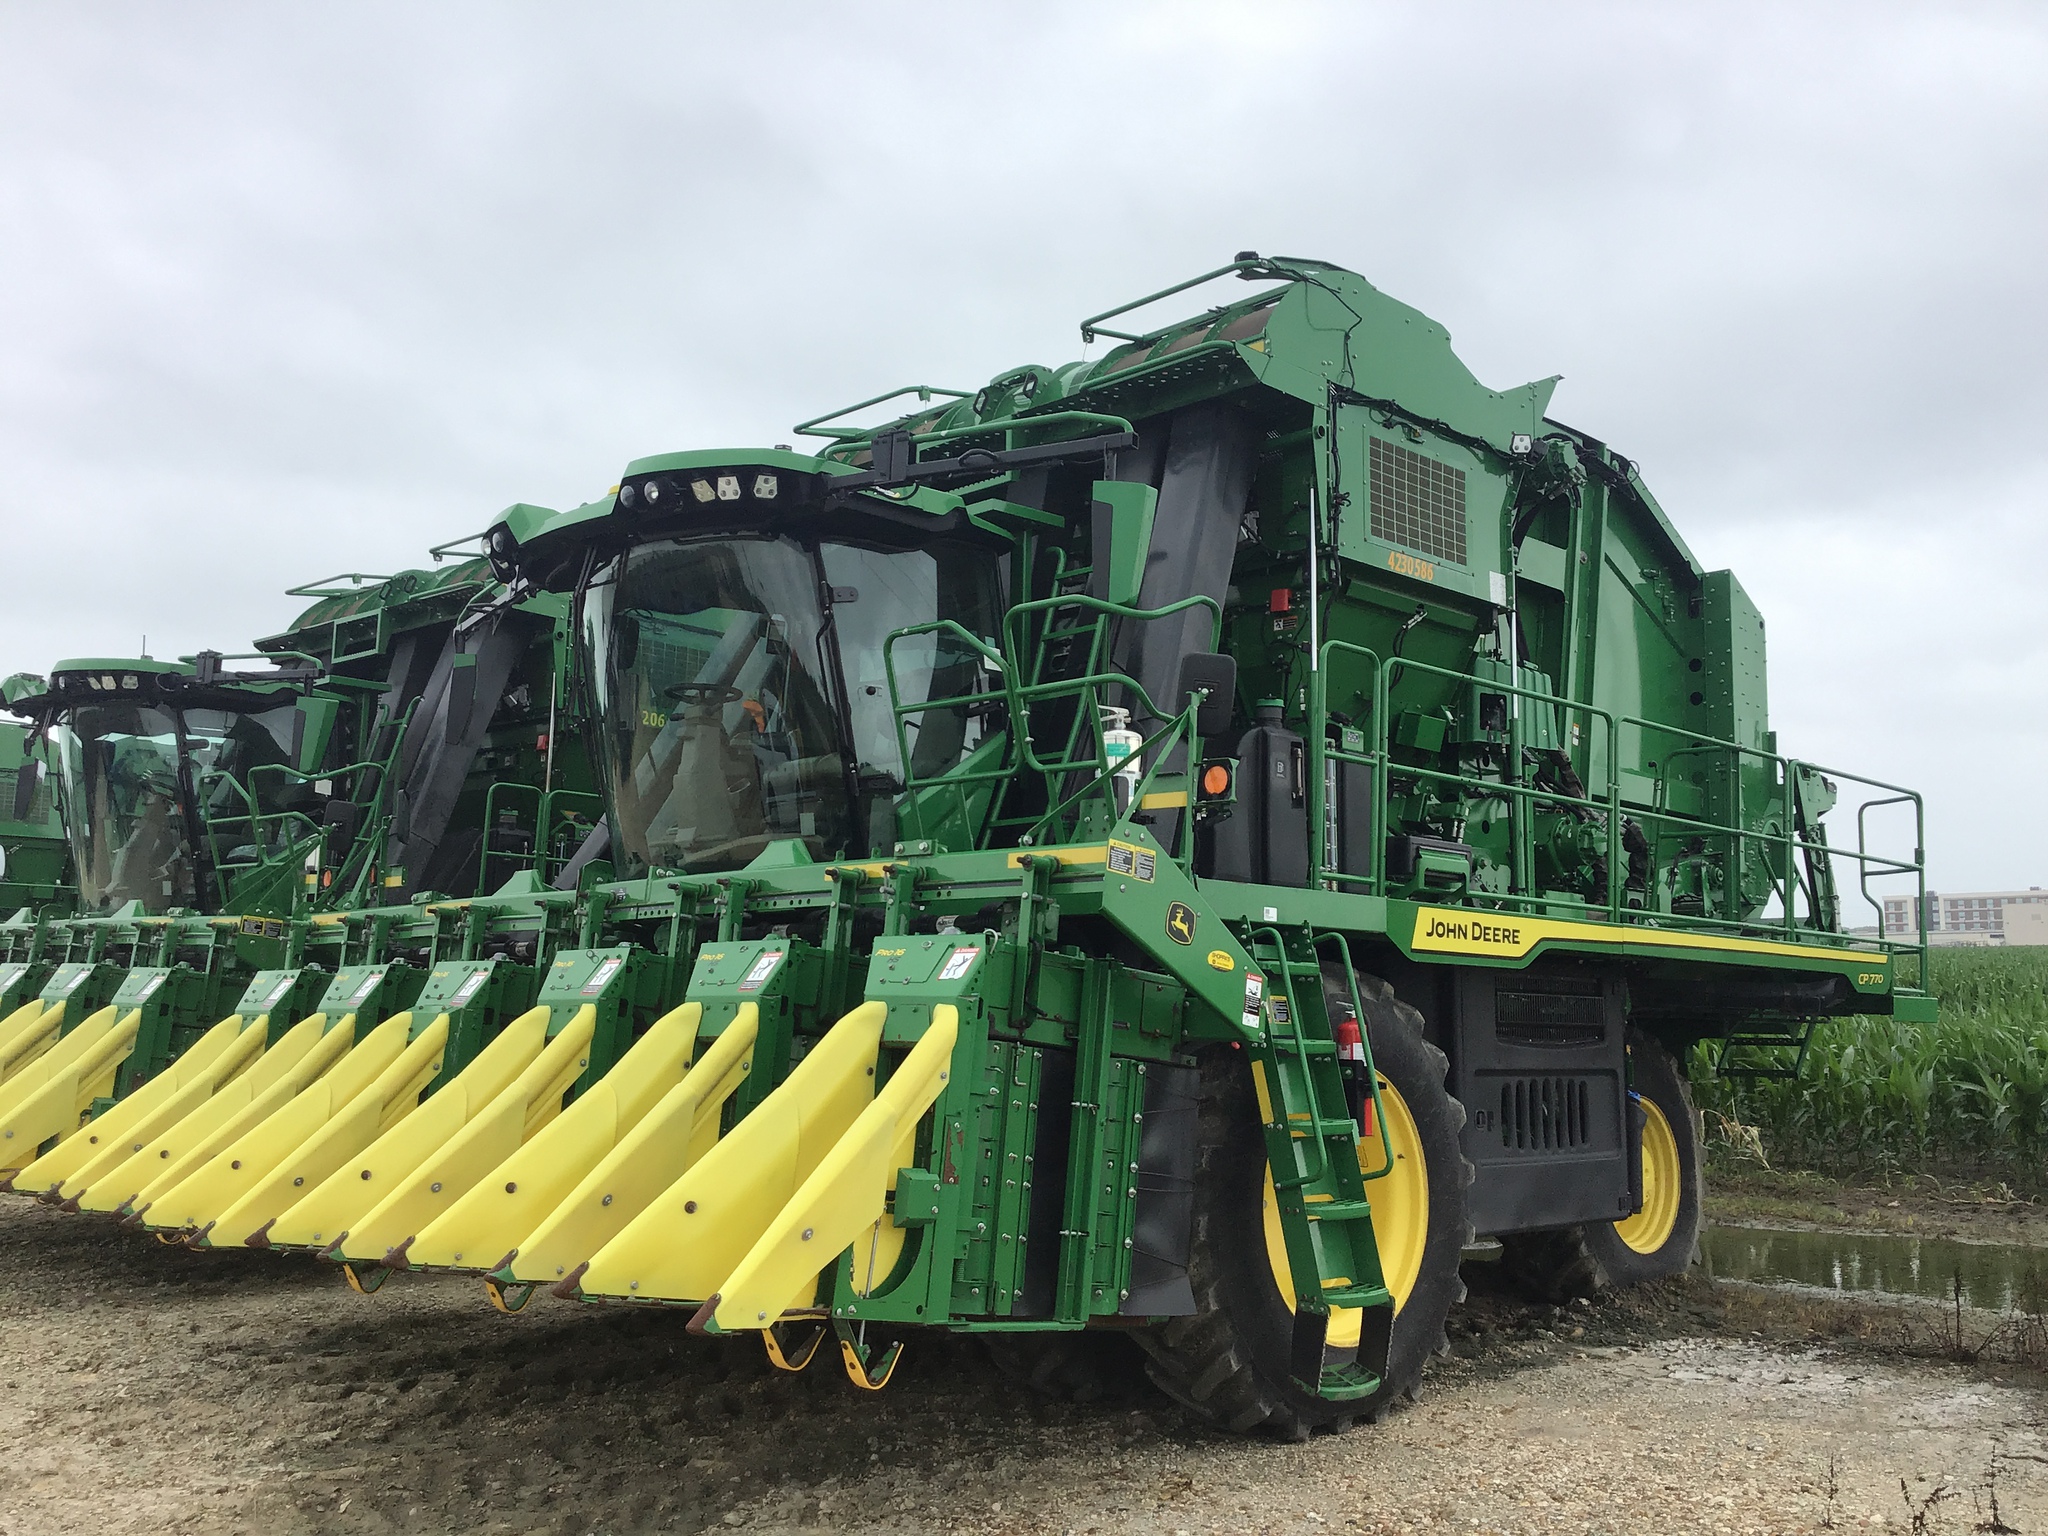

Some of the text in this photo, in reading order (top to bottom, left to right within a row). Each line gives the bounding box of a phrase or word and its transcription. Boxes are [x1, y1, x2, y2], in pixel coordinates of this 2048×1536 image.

[1387, 551, 1434, 581] 4230586
[642, 710, 665, 728] 206
[1426, 917, 1520, 945] JOHN DEERE
[1858, 973, 1884, 985] CP 770
